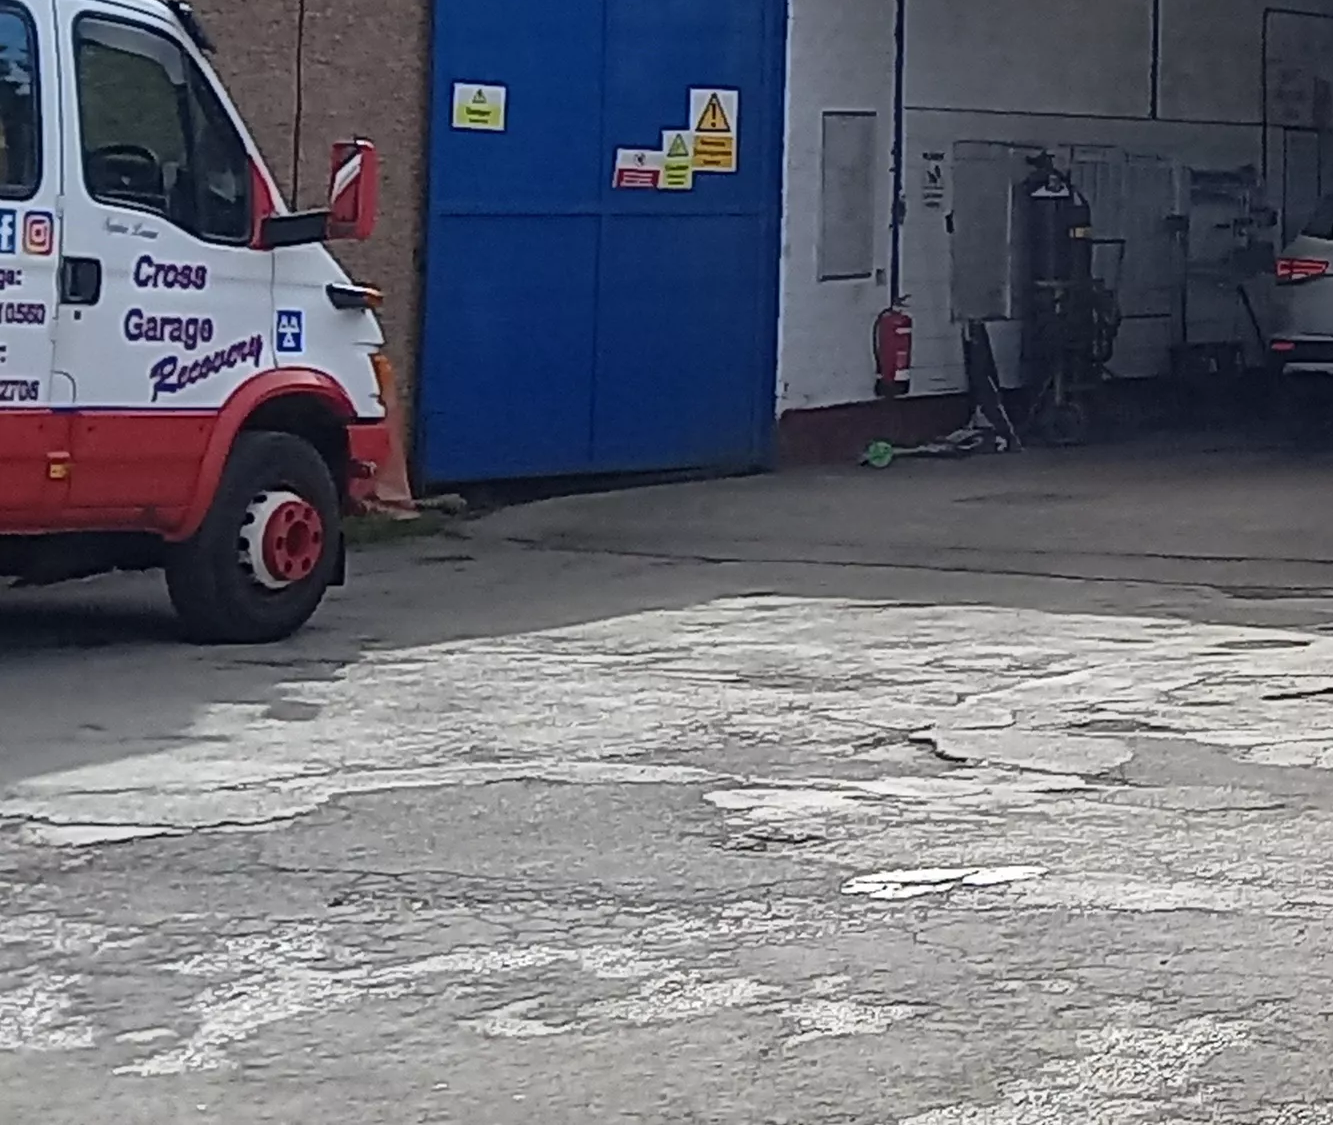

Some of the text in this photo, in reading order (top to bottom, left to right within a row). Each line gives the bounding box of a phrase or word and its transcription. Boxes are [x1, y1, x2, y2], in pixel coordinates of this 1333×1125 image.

[133, 254, 208, 291] Cross
[123, 308, 214, 351] Garage
[149, 334, 263, 403] Recovery
